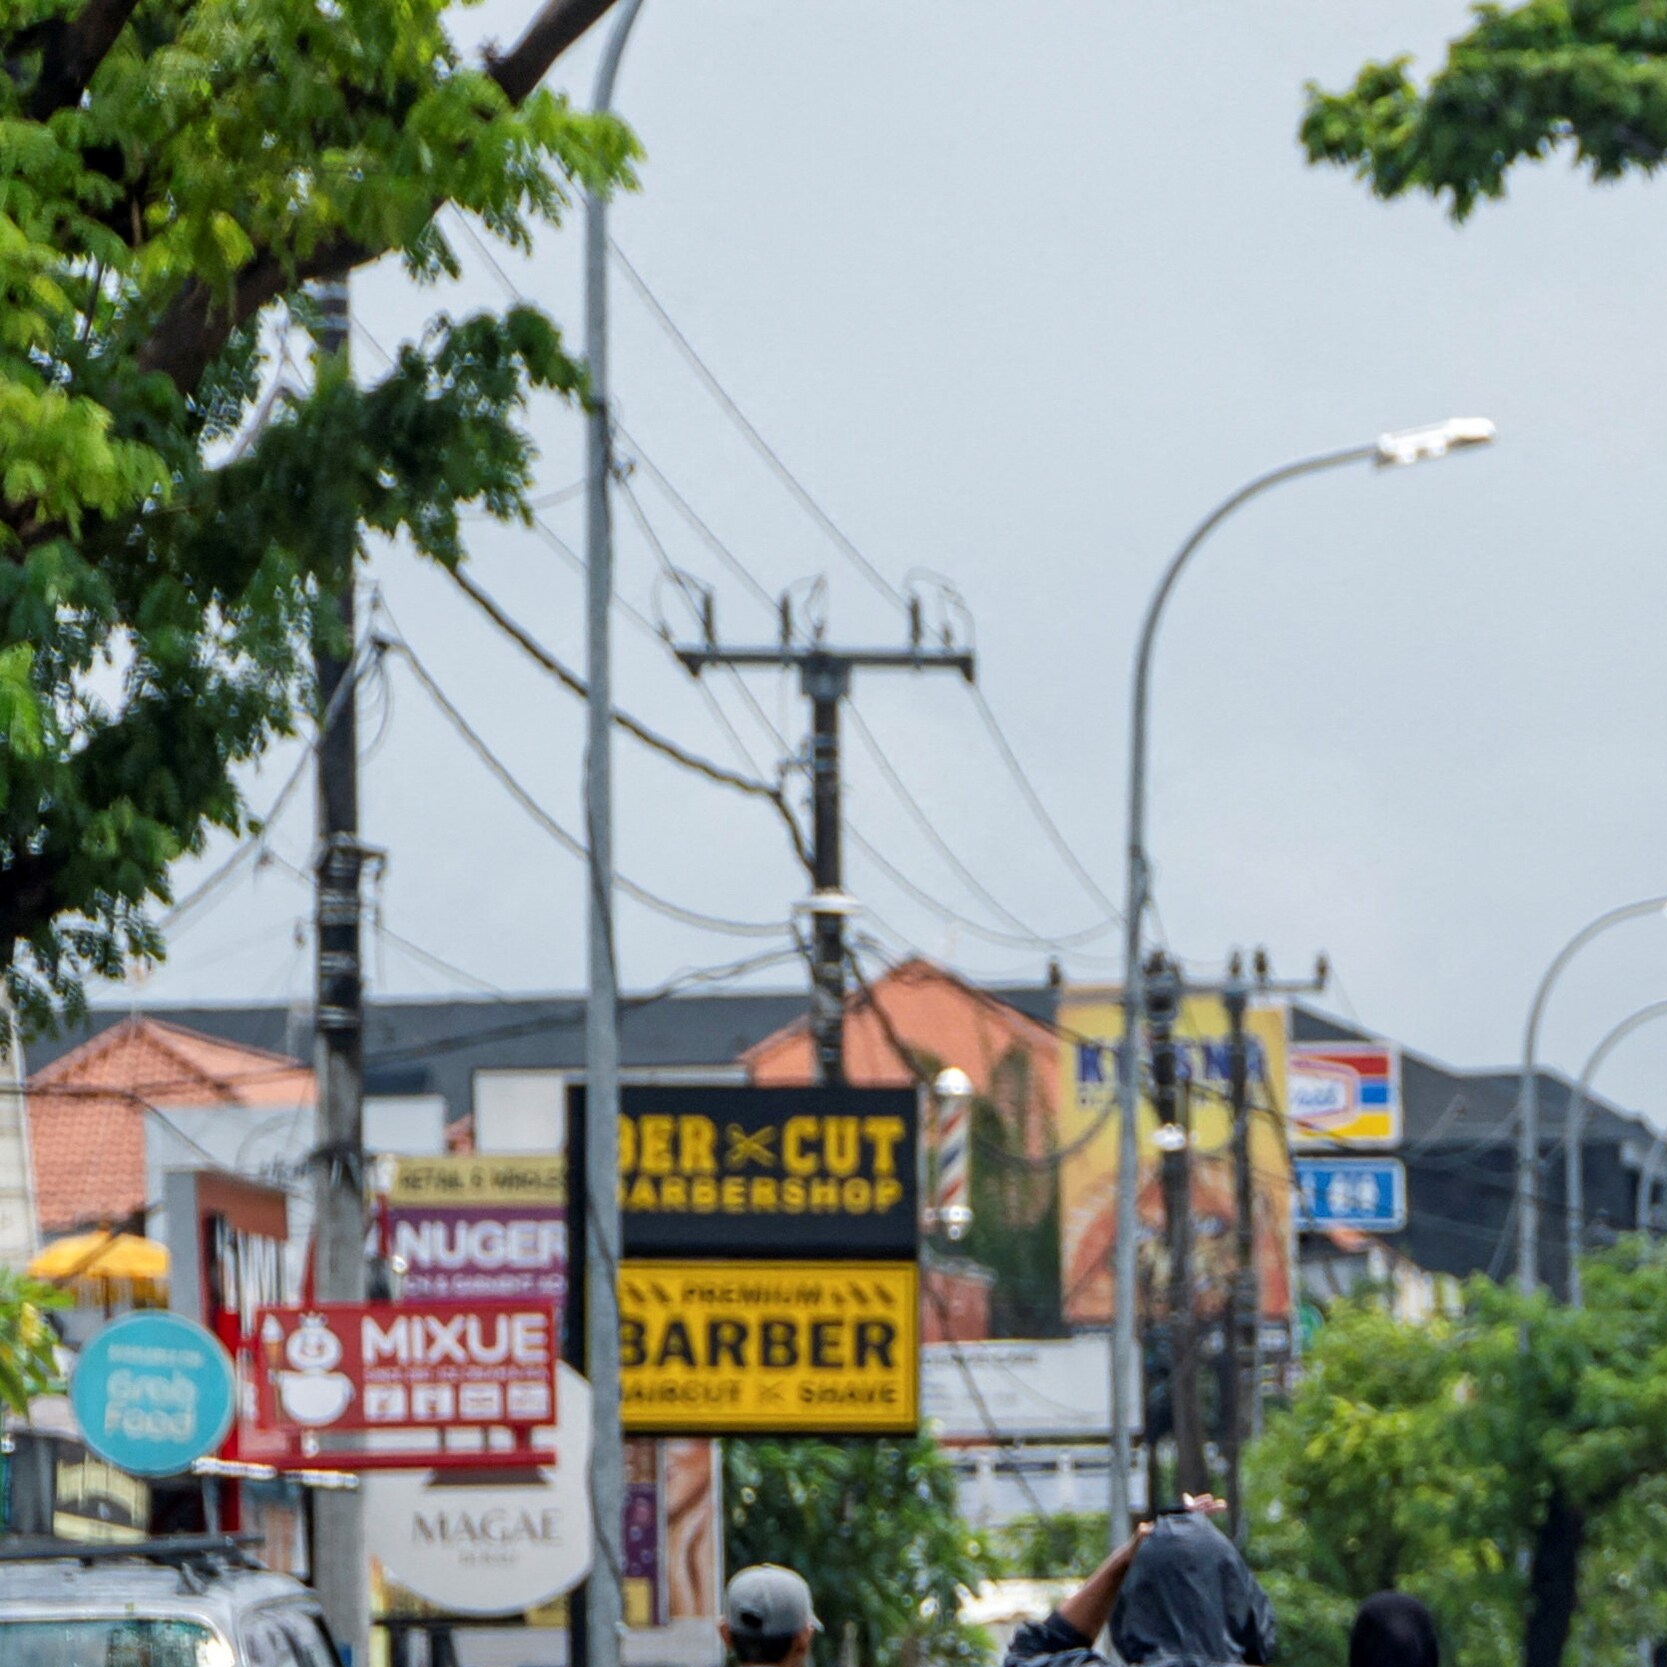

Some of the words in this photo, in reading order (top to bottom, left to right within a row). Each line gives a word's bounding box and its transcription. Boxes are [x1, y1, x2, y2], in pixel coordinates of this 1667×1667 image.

[783, 1114, 905, 1176] CUT
[617, 1174, 902, 1215] ARBERSHOP
[361, 1313, 549, 1365] MIXUE
[618, 1379, 743, 1404] AIRCUT
[800, 1380, 898, 1405] SHAVE
[105, 1399, 196, 1443] Food
[412, 1507, 562, 1544] MAGAE
